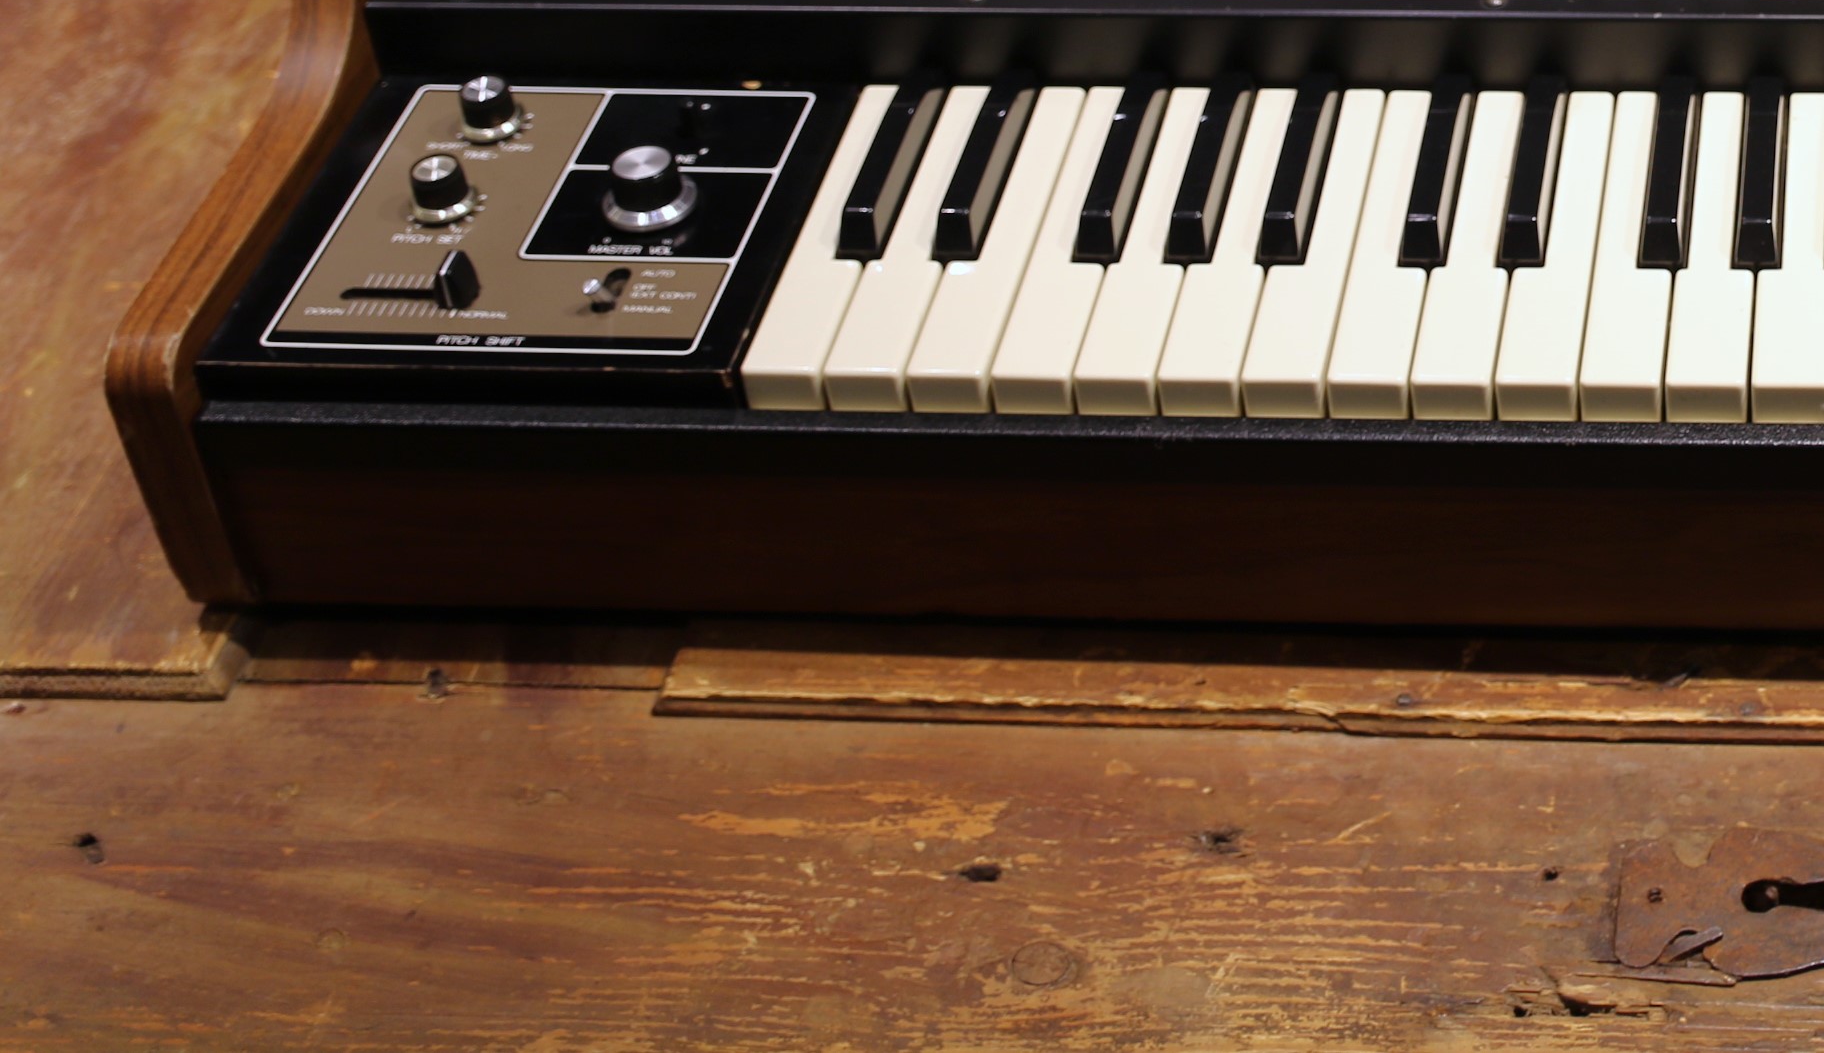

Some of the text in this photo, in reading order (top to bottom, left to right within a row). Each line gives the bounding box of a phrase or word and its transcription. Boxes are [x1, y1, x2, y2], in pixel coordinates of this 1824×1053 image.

[588, 244, 674, 256] MASTER VOL
[435, 335, 526, 347] PITCH SHIFT
